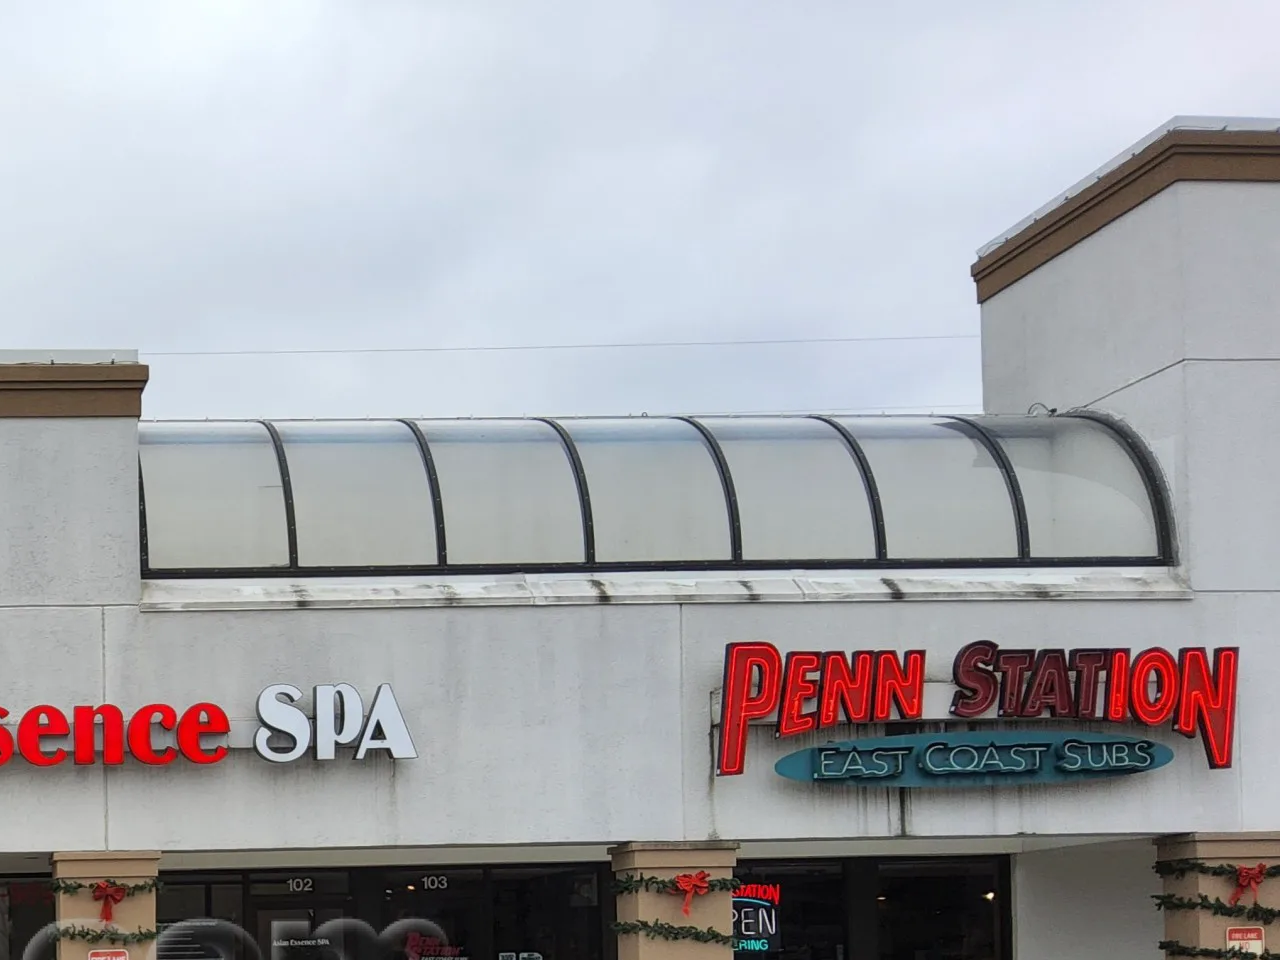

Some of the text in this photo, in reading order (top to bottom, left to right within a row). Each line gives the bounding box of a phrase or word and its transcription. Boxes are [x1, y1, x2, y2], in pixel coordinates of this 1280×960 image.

[716, 639, 1240, 776] PENN STATION
[253, 682, 419, 764] SPA
[817, 741, 1153, 778] EAST COAST SUBS
[286, 878, 313, 892] 102
[421, 876, 448, 889] 103
[272, 939, 289, 947] Asian
[317, 938, 330, 946] SPA
